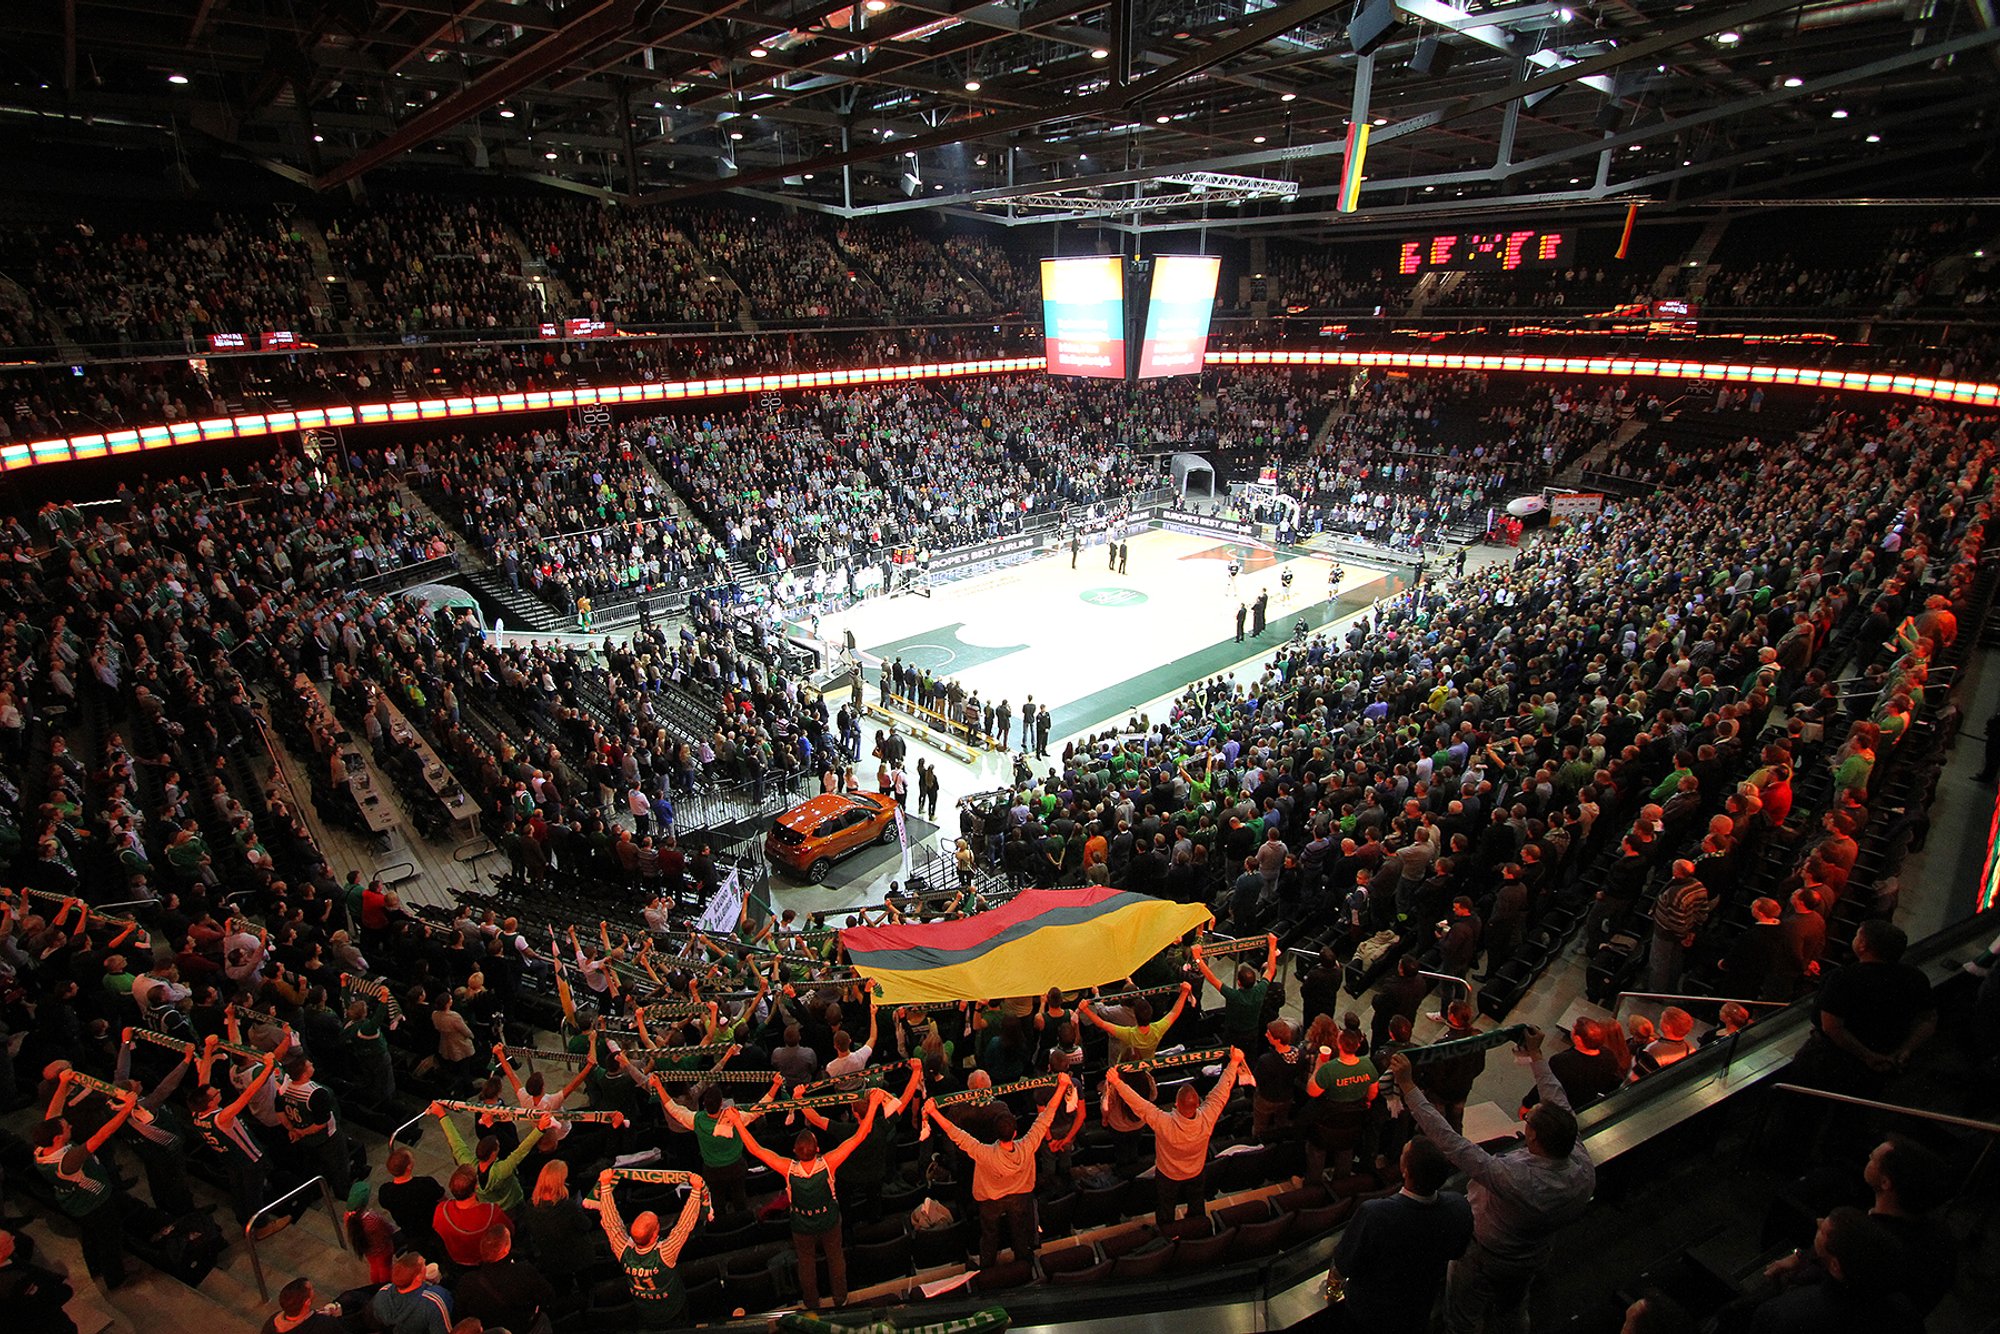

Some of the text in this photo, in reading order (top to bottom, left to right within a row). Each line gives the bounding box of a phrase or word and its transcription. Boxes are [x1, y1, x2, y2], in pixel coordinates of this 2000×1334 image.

[1200, 517, 1221, 529] BEST
[971, 546, 997, 559] BEST
[998, 538, 1034, 553] AIRLINE
[944, 1076, 1052, 1103] GREEN LEGION
[1336, 1073, 1371, 1087] LIETUVA
[285, 1104, 302, 1124] 96
